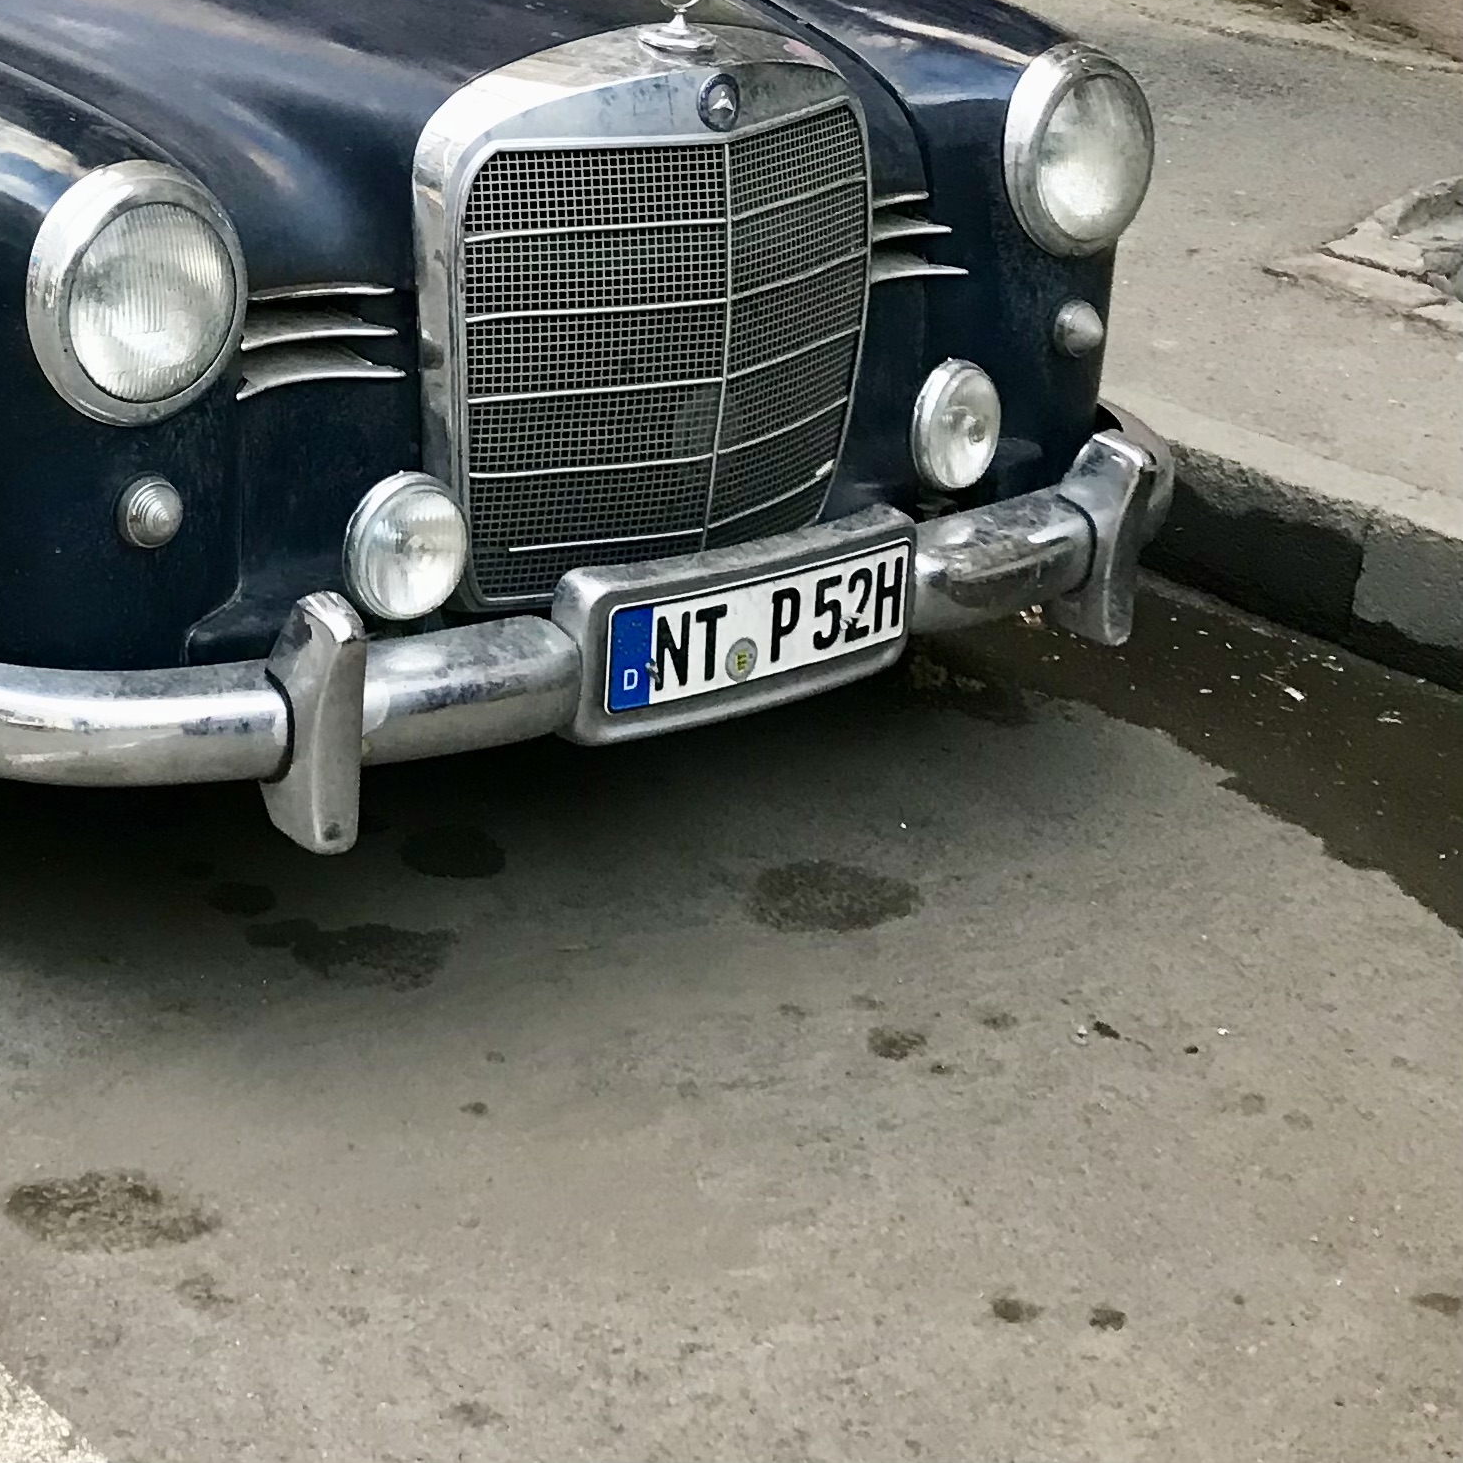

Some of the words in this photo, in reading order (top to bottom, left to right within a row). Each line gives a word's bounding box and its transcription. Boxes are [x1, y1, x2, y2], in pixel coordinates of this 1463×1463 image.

[654, 603, 728, 692] NT
[770, 586, 801, 663] P
[812, 556, 904, 651] 52H
[623, 668, 639, 691] D
